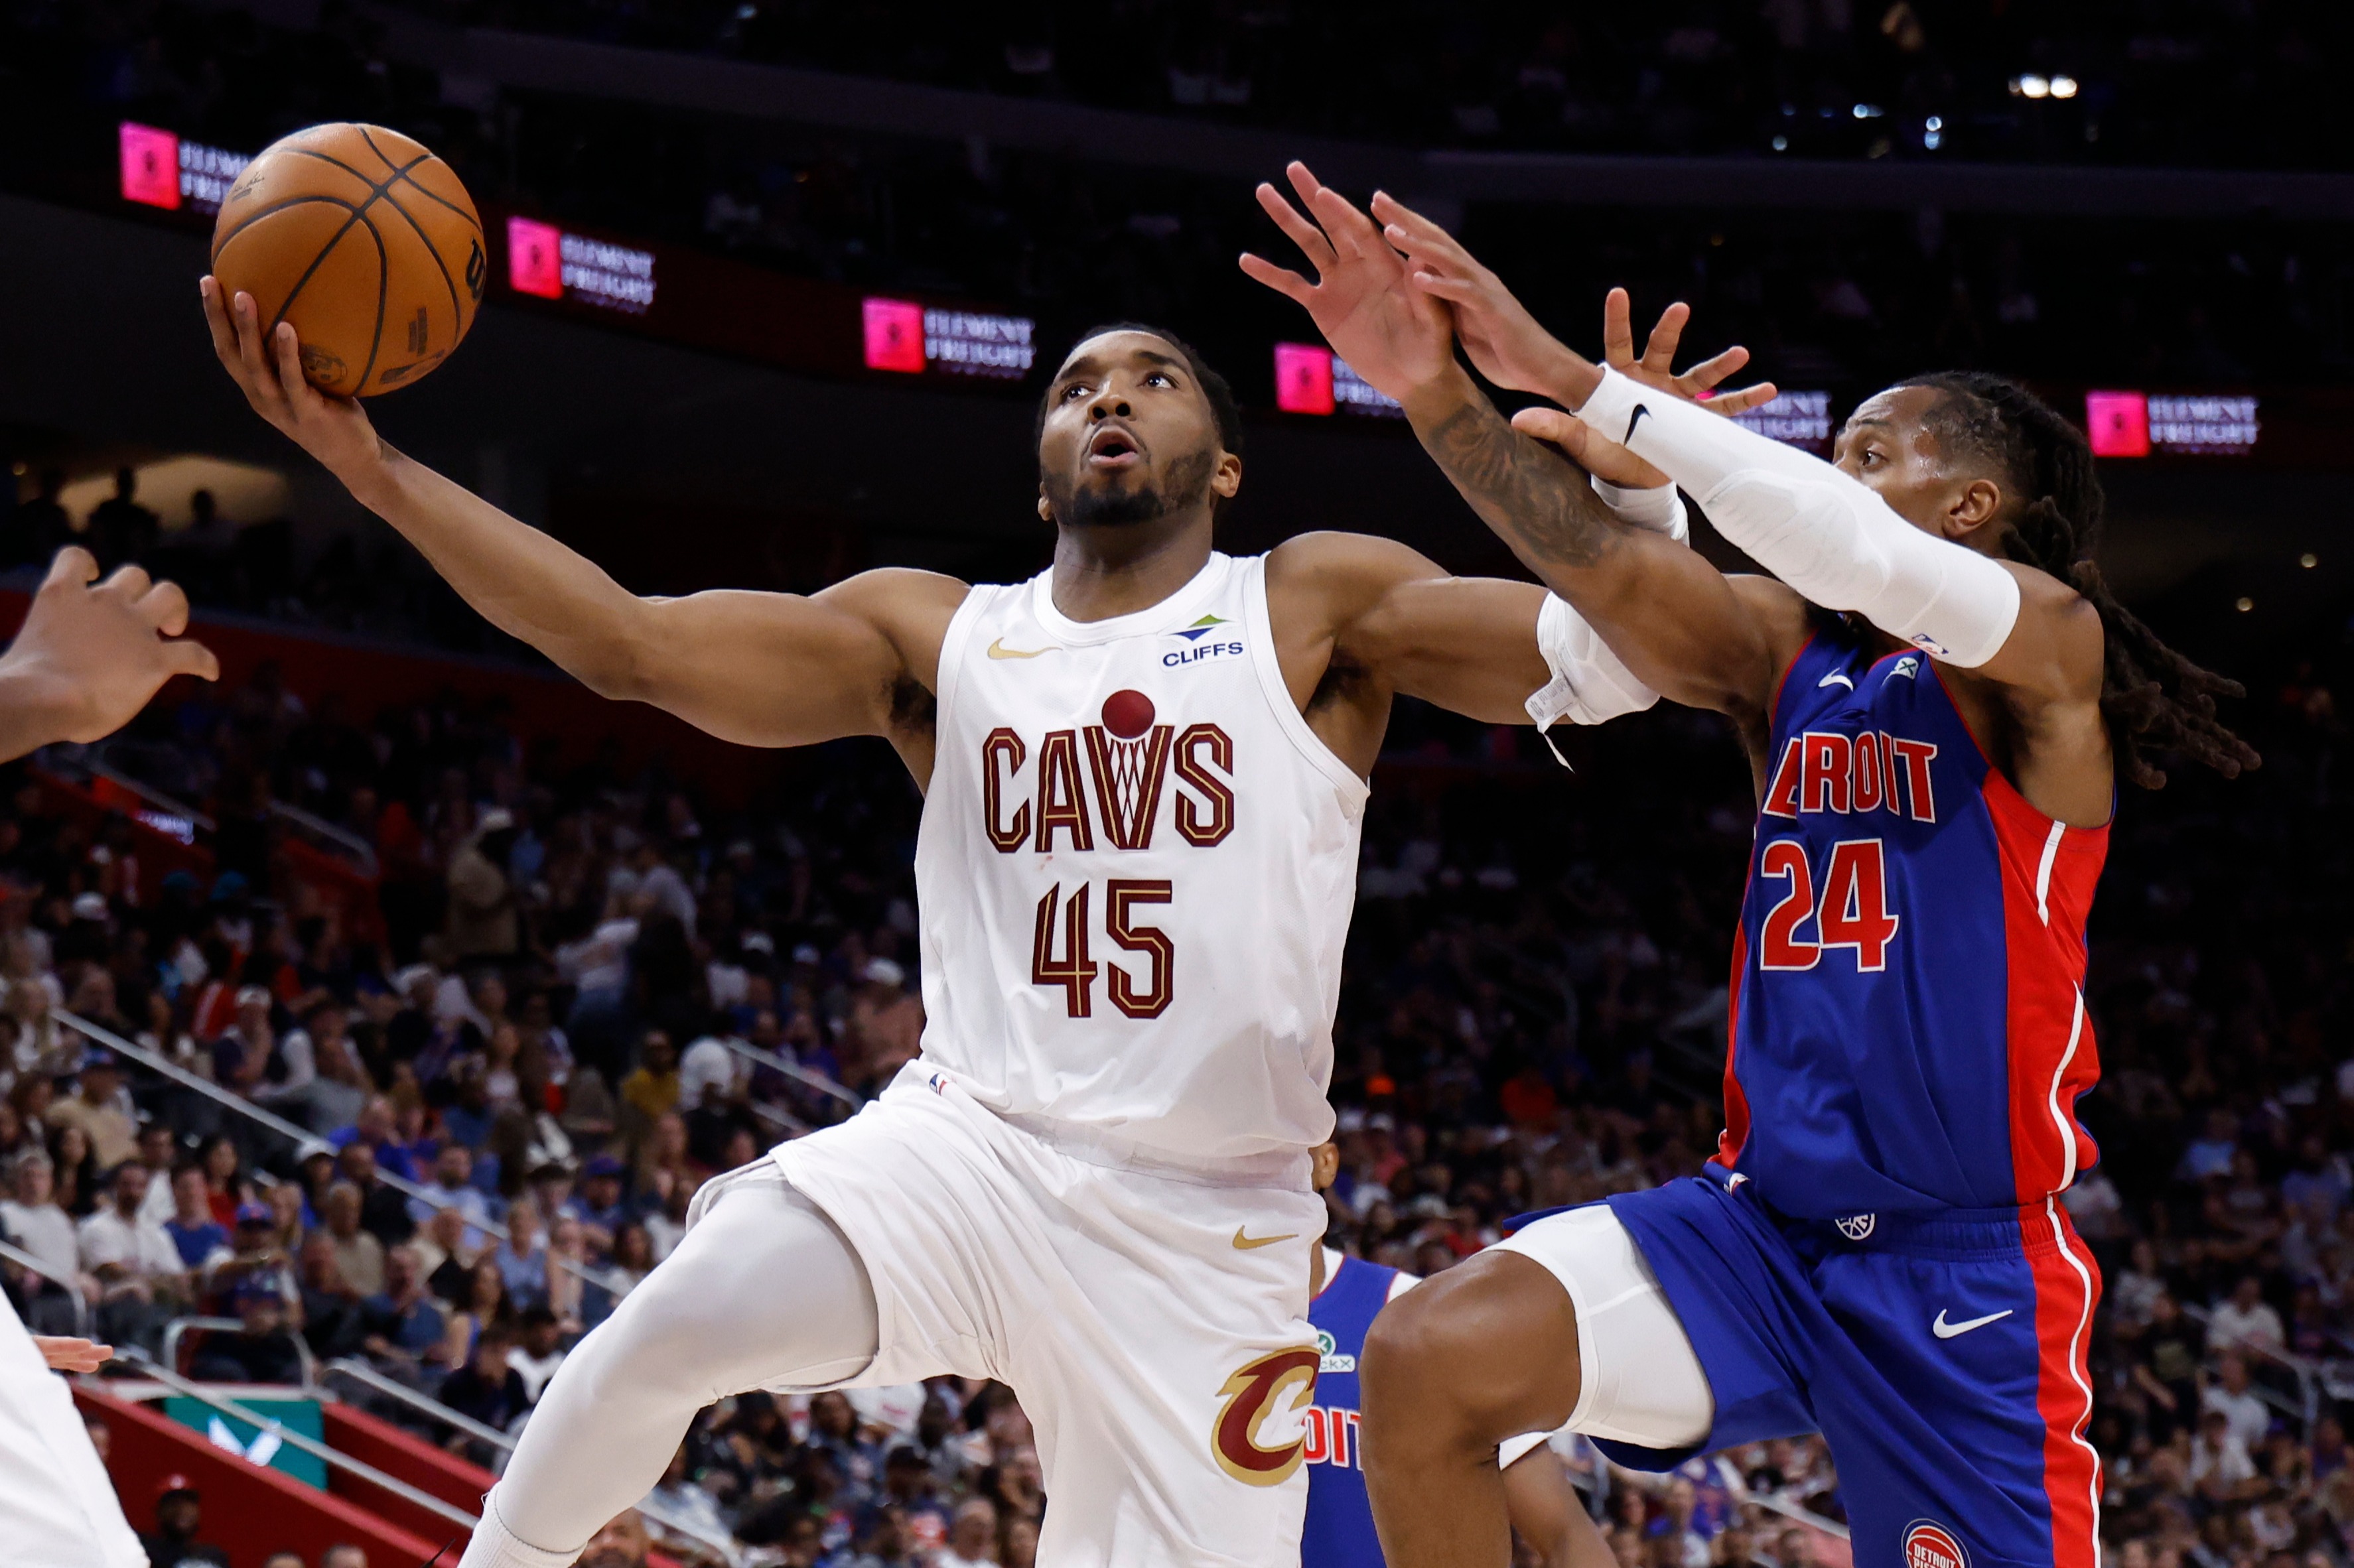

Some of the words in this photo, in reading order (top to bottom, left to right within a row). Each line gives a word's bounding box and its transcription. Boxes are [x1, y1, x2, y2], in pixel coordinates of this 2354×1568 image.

[1162, 641, 1243, 667] CLIFFS
[982, 722, 1235, 854] CAVS
[1032, 878, 1174, 1019] 45
[1760, 838, 1899, 972] 24
